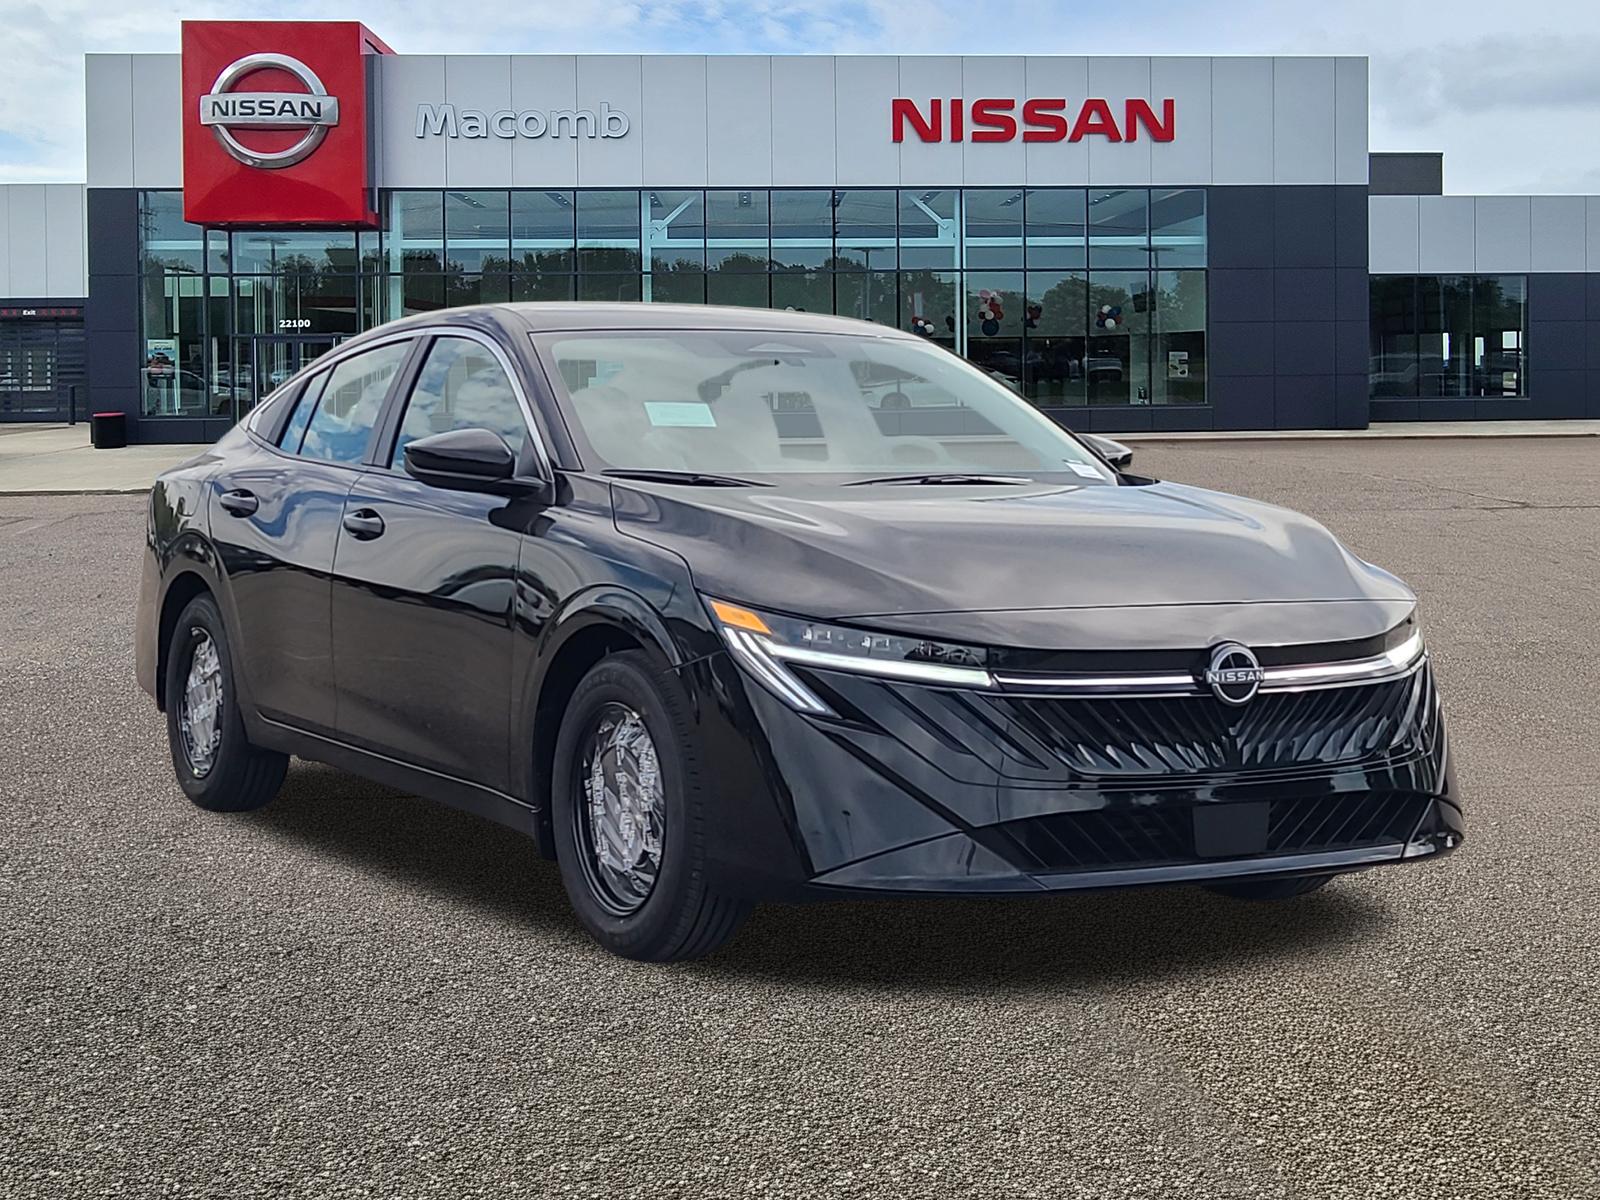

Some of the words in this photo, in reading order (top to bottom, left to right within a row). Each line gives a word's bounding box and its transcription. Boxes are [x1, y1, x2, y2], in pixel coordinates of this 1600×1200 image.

[212, 100, 321, 117] NISSAN
[415, 102, 629, 138] Macomb
[892, 98, 1175, 143] NISSAN
[279, 319, 311, 328] 22100
[1208, 670, 1264, 682] NISSAN
